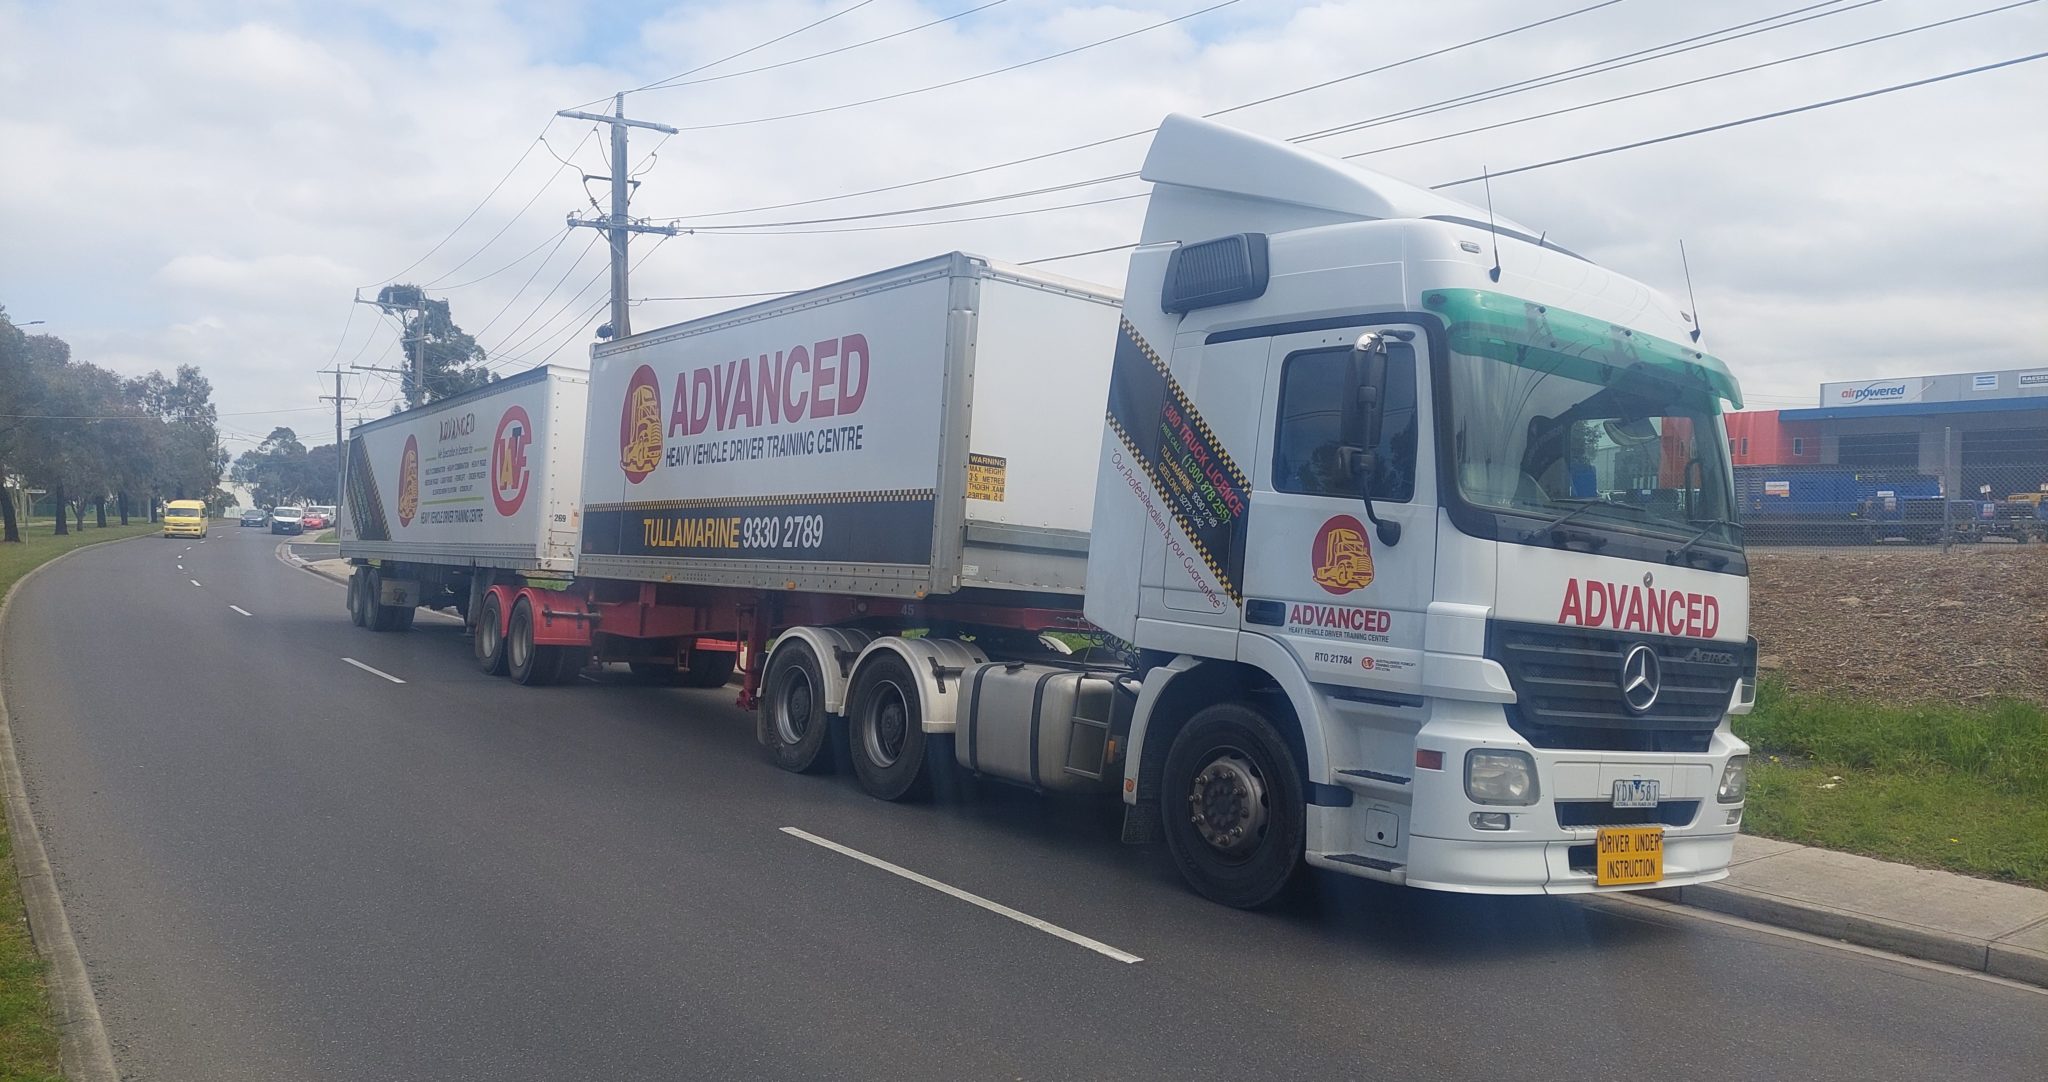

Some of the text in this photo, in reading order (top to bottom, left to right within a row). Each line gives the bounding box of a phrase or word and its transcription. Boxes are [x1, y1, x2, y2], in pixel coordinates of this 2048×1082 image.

[667, 333, 870, 438] ADVANCED
[1841, 384, 1905, 399] airpowered
[665, 425, 864, 468] HEAVY VEHICLE DRIVER TRAINING CENTRE
[970, 455, 1004, 466] WARNING
[1161, 401, 1245, 517] 1300 TRUCK LICENCE
[982, 476, 1004, 484] METRES
[984, 467, 1005, 476] HEIGHT
[1160, 422, 1232, 524] FREE CALL (1300 878 255)
[1161, 444, 1195, 494] TULLAMARINE
[1191, 491, 1206, 511] 9330
[1158, 462, 1181, 497] GEELONG
[1179, 493, 1193, 513] 5272
[554, 514, 567, 522] 269
[644, 514, 824, 549] TULLAMARINE 9330 2789
[1167, 537, 1185, 560] your
[902, 604, 915, 615] 45
[1289, 604, 1391, 633] ADVANCED
[1558, 578, 1719, 639] ADVANCED
[1288, 626, 1390, 643] HEAVY VEHICLE DRIVER TRAINING CENTRE
[1314, 652, 1329, 662] RTO
[1330, 654, 1352, 665] 21784
[1616, 784, 1657, 801] YDN 581
[1601, 833, 1660, 853] DRIVER UNDER
[1607, 858, 1656, 879] INSTRUCTION
